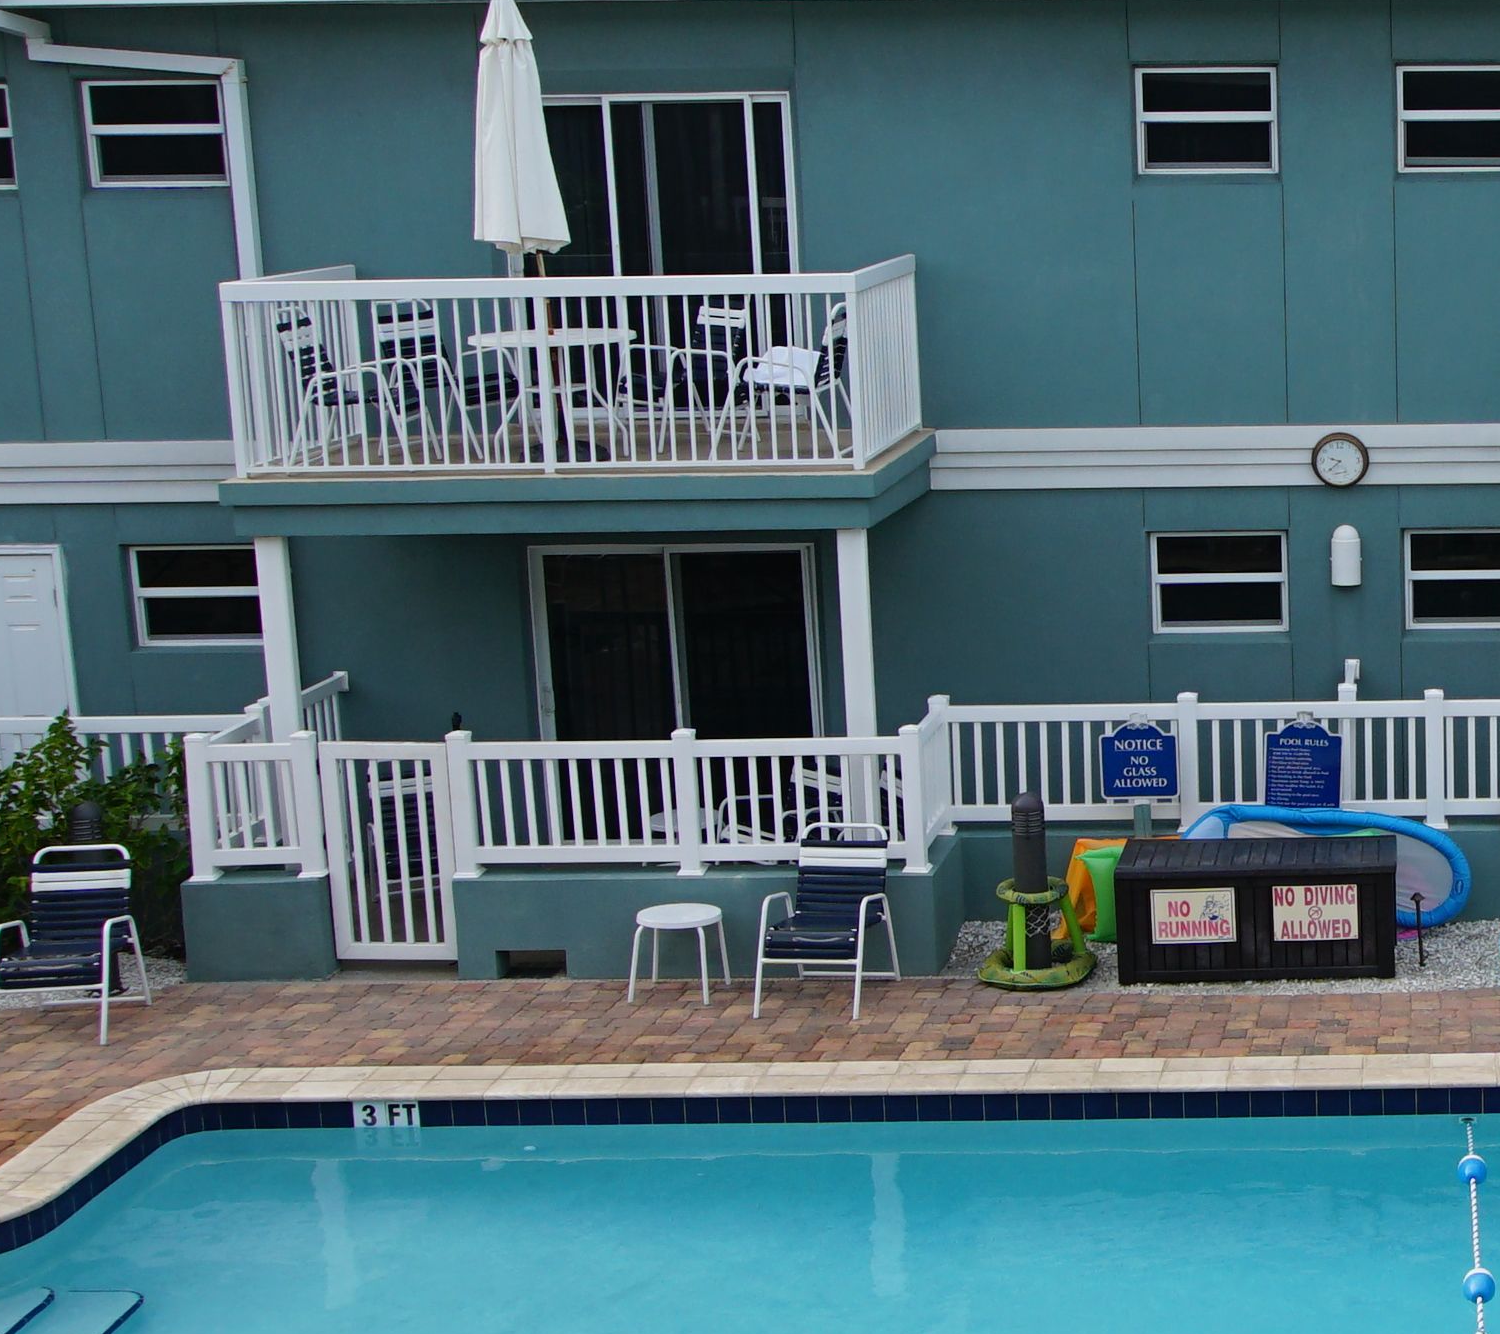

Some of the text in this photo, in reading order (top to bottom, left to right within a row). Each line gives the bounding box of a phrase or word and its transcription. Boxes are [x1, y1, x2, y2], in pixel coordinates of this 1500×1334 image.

[1114, 739, 1163, 751] NOTICE
[1280, 738, 1329, 747] POOL RULES
[1130, 756, 1149, 765] NO
[1123, 767, 1157, 776] GLASS
[1113, 778, 1168, 788] ALLOWED
[1274, 886, 1356, 907] NO DIVING
[1168, 900, 1191, 918] NO
[1158, 919, 1231, 939] RUNNING
[1280, 919, 1352, 940] ALLOWED
[362, 1103, 417, 1127] 3 FT
